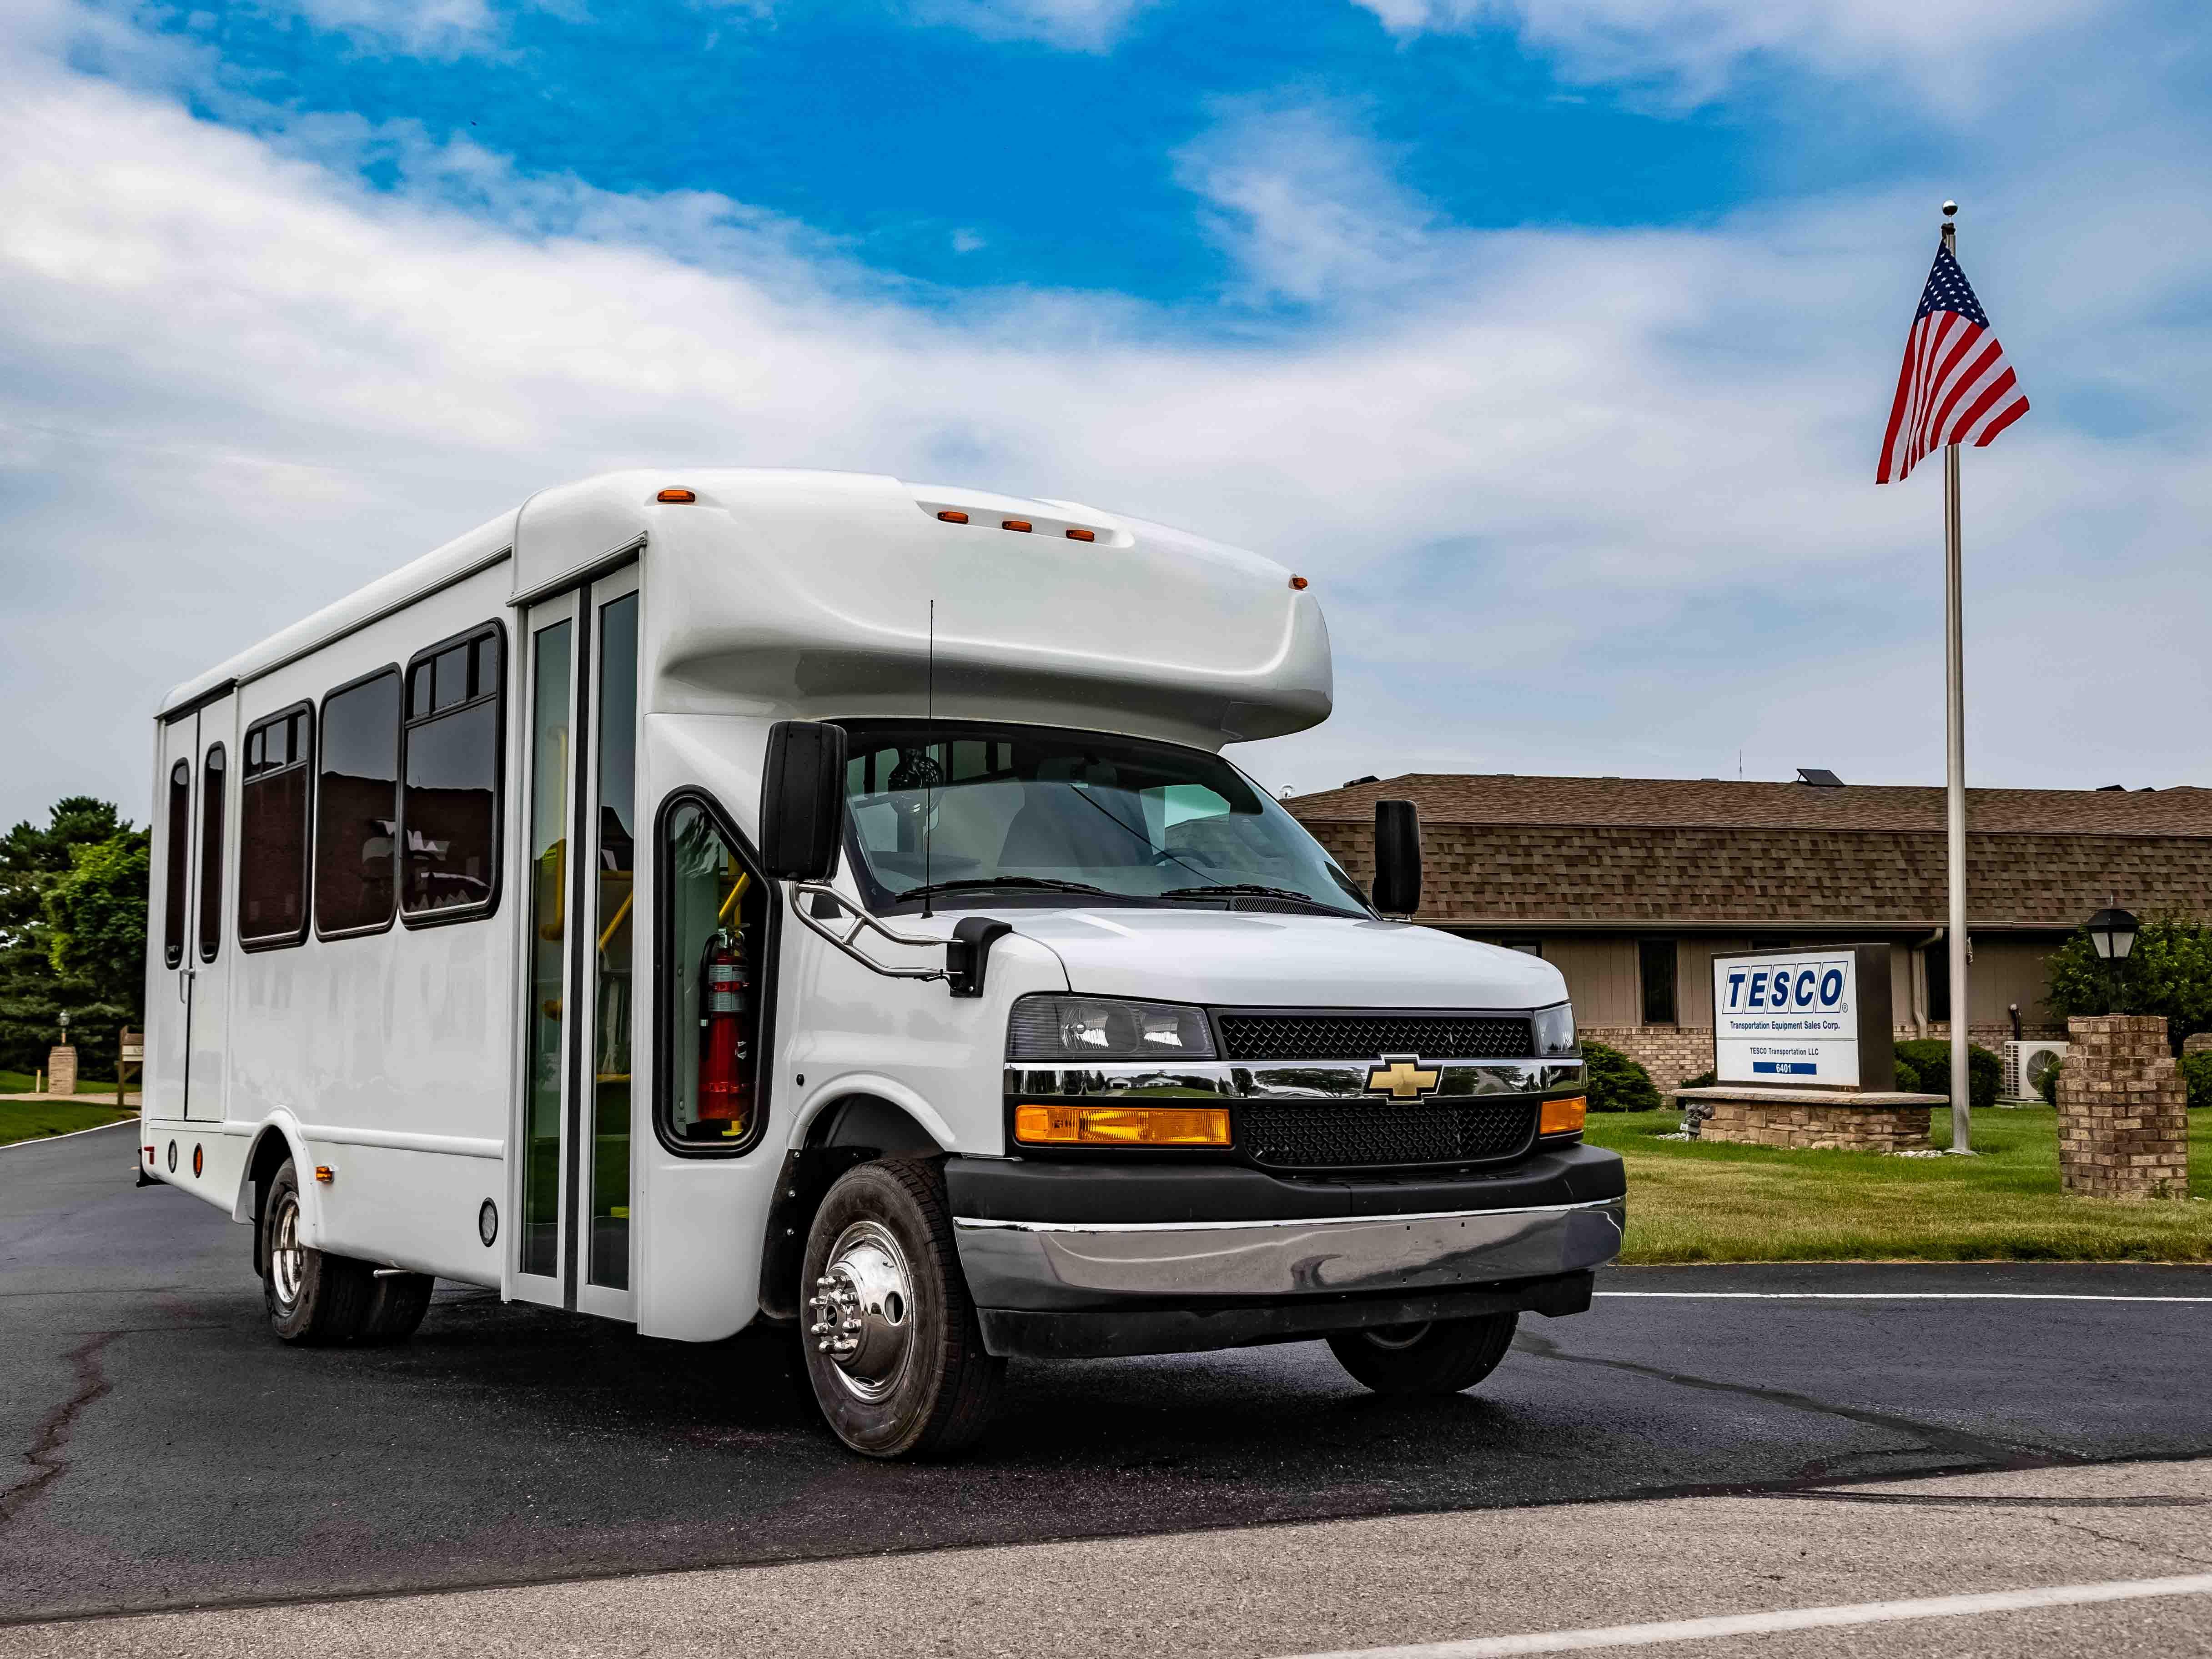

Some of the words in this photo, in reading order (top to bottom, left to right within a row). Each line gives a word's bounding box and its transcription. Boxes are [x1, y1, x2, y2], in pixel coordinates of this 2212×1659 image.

[1729, 969, 1842, 1007] TESCO
[1730, 1021, 1770, 1031] Transportation
[1772, 1021, 1802, 1031] Equipment
[1805, 1021, 1820, 1029] Sales
[1823, 1021, 1840, 1031] Corp.
[1776, 1064, 1791, 1073] 6401
